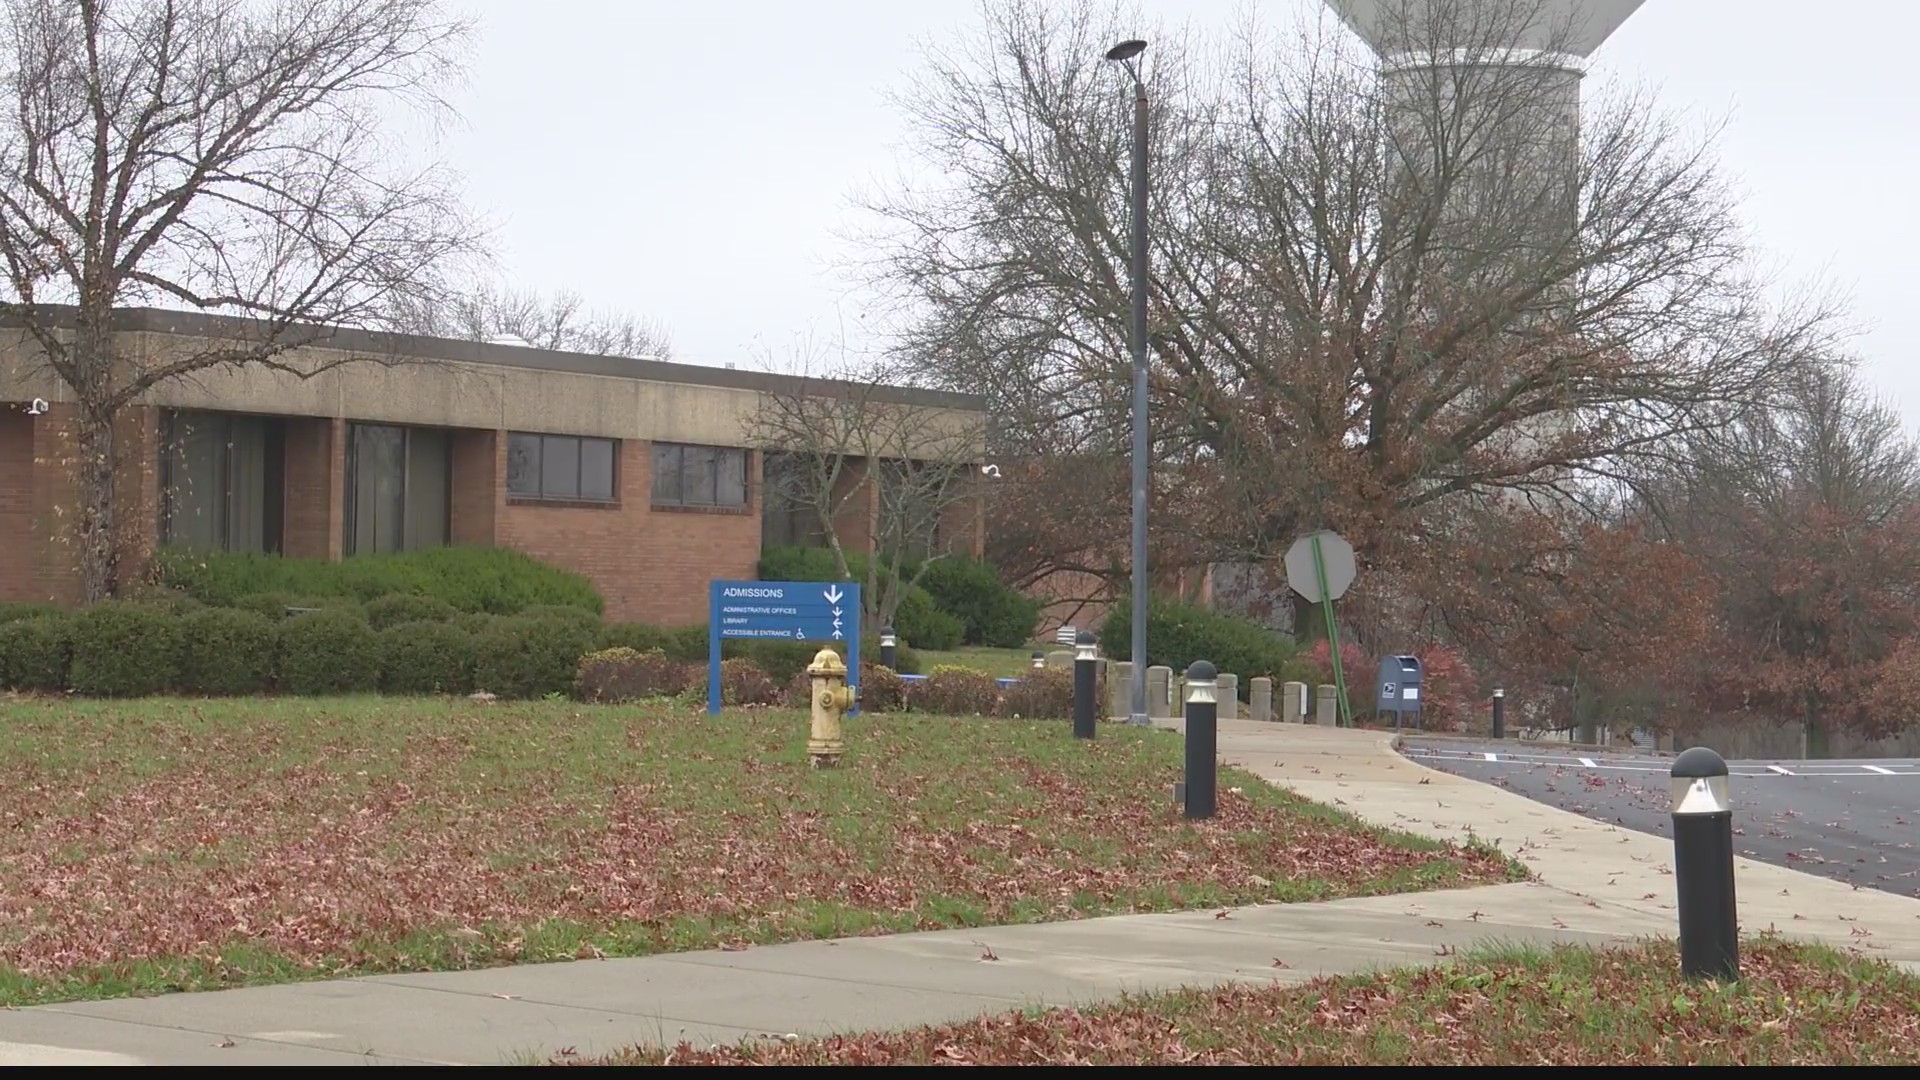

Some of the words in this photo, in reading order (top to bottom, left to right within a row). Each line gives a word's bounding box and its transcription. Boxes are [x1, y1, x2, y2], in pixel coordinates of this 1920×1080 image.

[723, 588, 784, 598] ADMISSIONS
[723, 606, 770, 614] ADMINISTRATIVE
[772, 607, 797, 615] OFFICES
